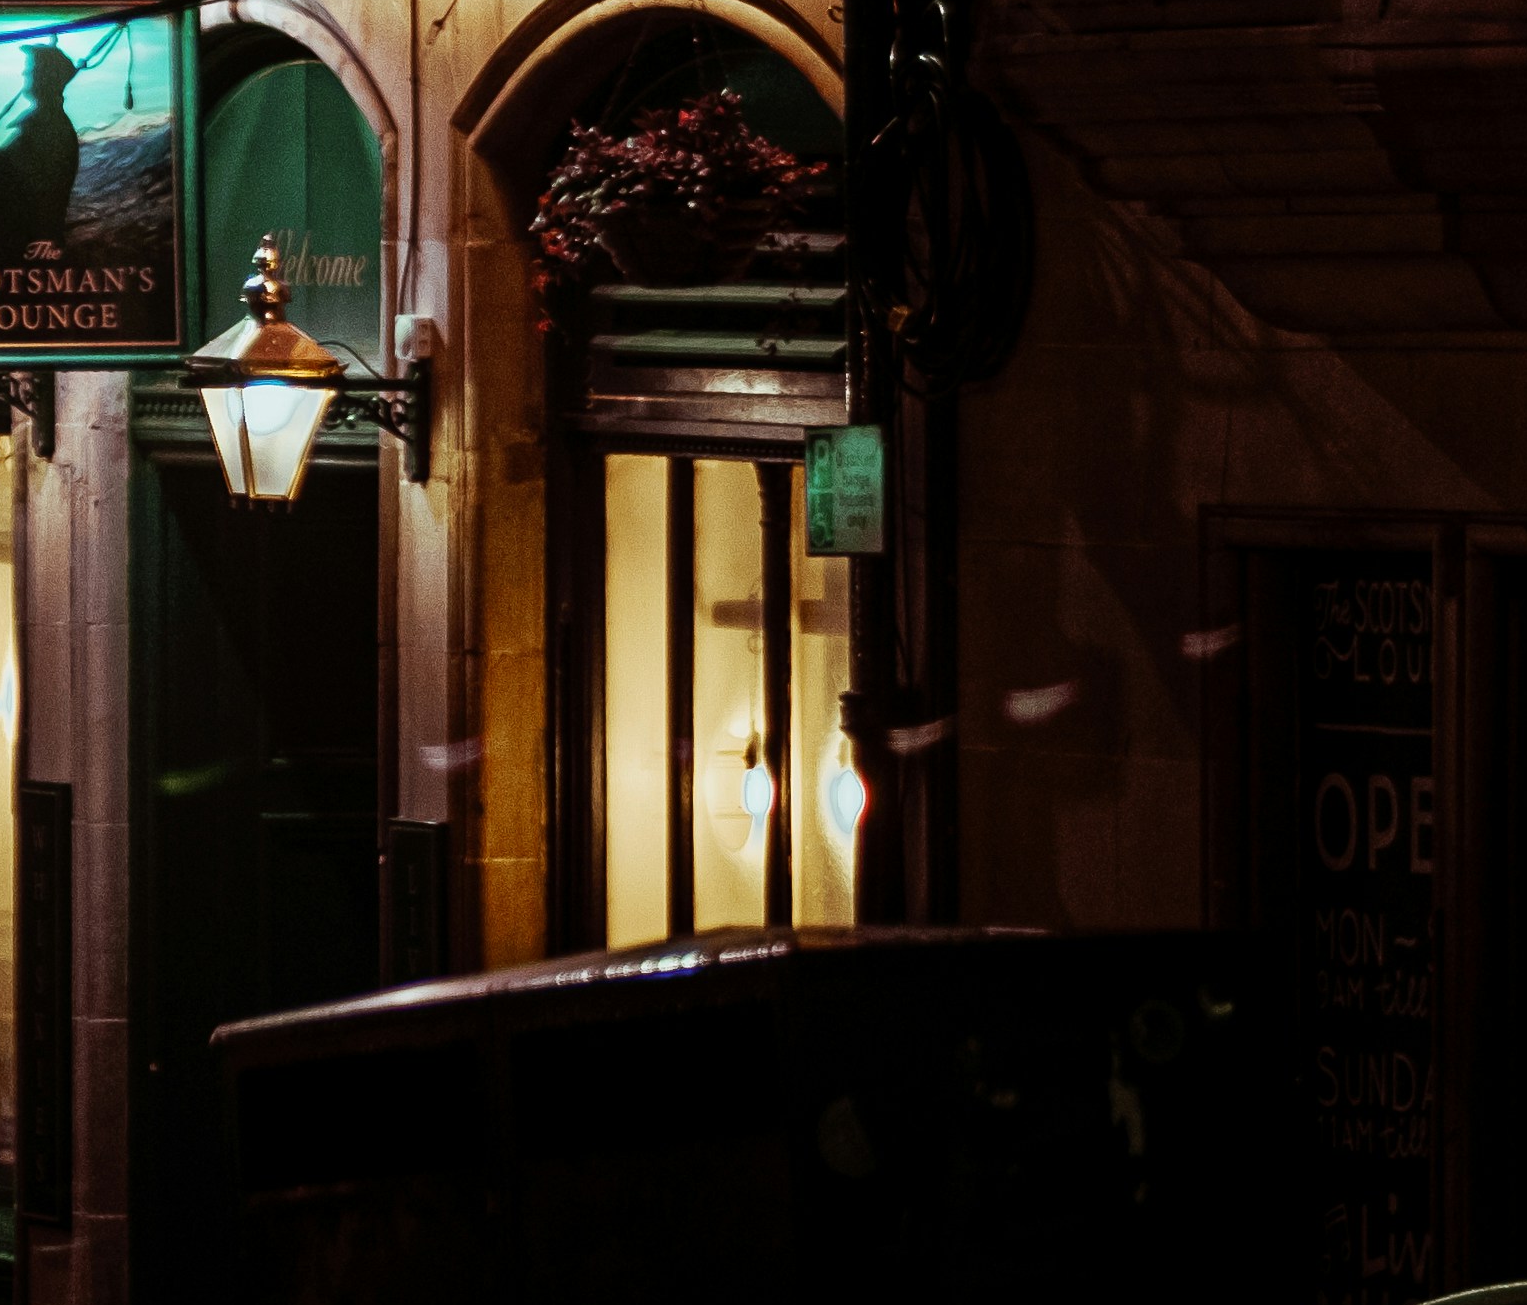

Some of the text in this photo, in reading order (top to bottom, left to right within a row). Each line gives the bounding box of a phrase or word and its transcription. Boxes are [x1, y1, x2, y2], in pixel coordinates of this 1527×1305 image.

[23, 240, 63, 261] The
[1313, 579, 1354, 632] The
[1316, 968, 1430, 1019] 9AM till
[1379, 1113, 1430, 1160] till
